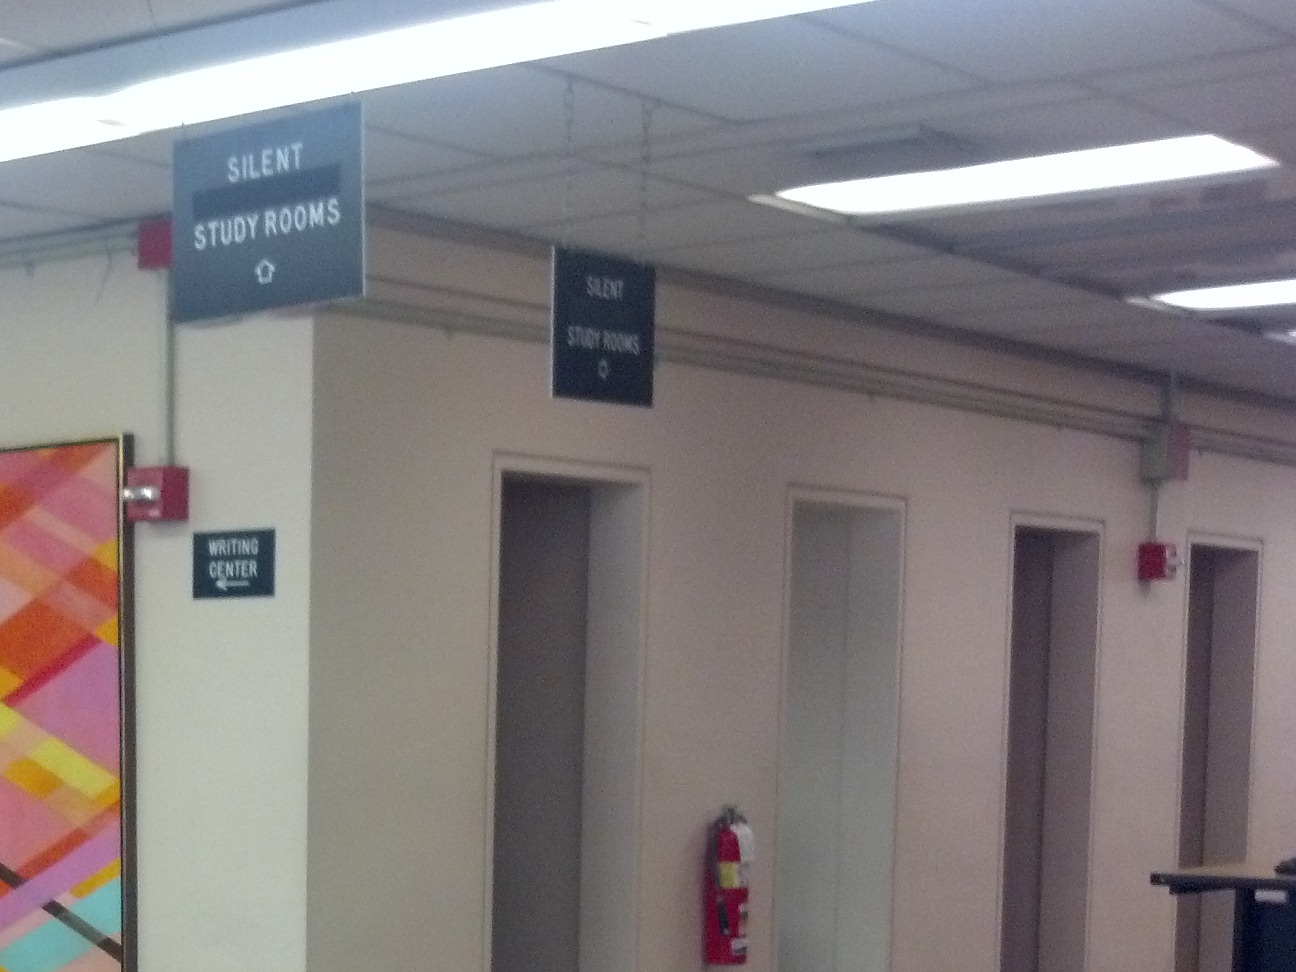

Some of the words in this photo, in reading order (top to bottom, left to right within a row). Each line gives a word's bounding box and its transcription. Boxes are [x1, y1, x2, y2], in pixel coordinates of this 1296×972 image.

[227, 142, 303, 183] SILENT
[194, 214, 258, 250] STUDY
[264, 197, 341, 237] ROOMS
[208, 537, 259, 556] WRITING
[209, 559, 258, 578] CENTER
